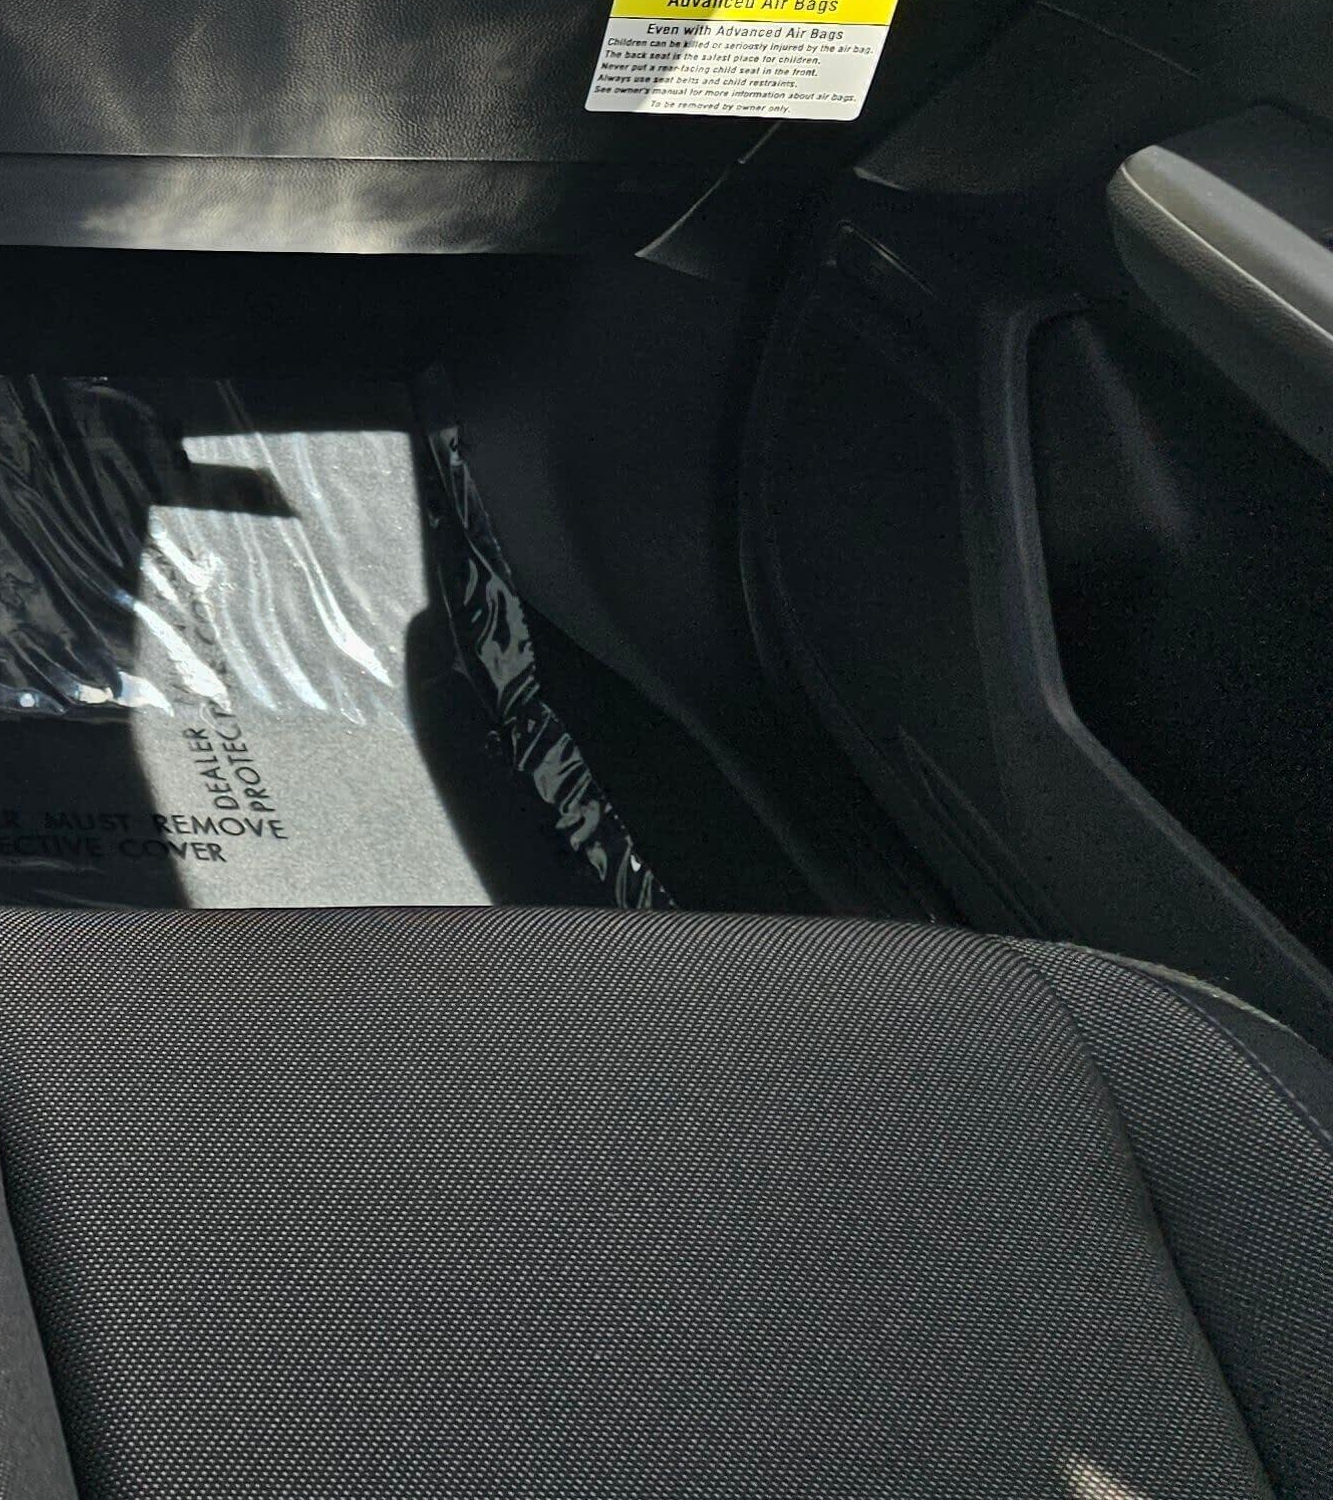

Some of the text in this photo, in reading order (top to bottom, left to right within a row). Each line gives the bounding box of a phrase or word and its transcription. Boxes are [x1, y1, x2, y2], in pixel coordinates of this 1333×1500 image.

[647, 23, 844, 42] Even with Advanced Air Bags
[607, 37, 647, 48] Children
[670, 40, 681, 48] be
[724, 42, 768, 52] seriously
[770, 42, 803, 52] injured
[806, 44, 817, 53] by
[820, 44, 835, 52] the
[605, 50, 621, 58] The
[625, 50, 646, 59] back
[650, 52, 671, 60] seat
[683, 52, 698, 61] the
[733, 54, 760, 63] place
[762, 55, 776, 63] for
[779, 56, 821, 65] children.
[601, 62, 630, 71] Never
[631, 63, 647, 72] put
[713, 65, 736, 74] child
[739, 67, 760, 75] seat
[774, 68, 789, 76] the
[597, 74, 631, 84] Always
[634, 76, 651, 84] use
[653, 76, 674, 84] seat
[702, 77, 720, 85] and
[723, 78, 747, 86] child
[594, 86, 612, 94] See
[652, 87, 688, 96] manual
[788, 92, 814, 100] about
[651, 100, 661, 108] To
[664, 101, 675, 109] be
[678, 102, 719, 110] removed
[722, 103, 733, 112] by
[736, 104, 766, 112] owner
[183, 727, 240, 810] DEALER
[44, 811, 130, 833] MUST
[151, 813, 289, 840] REMOVE
[119, 838, 227, 863] COVER
